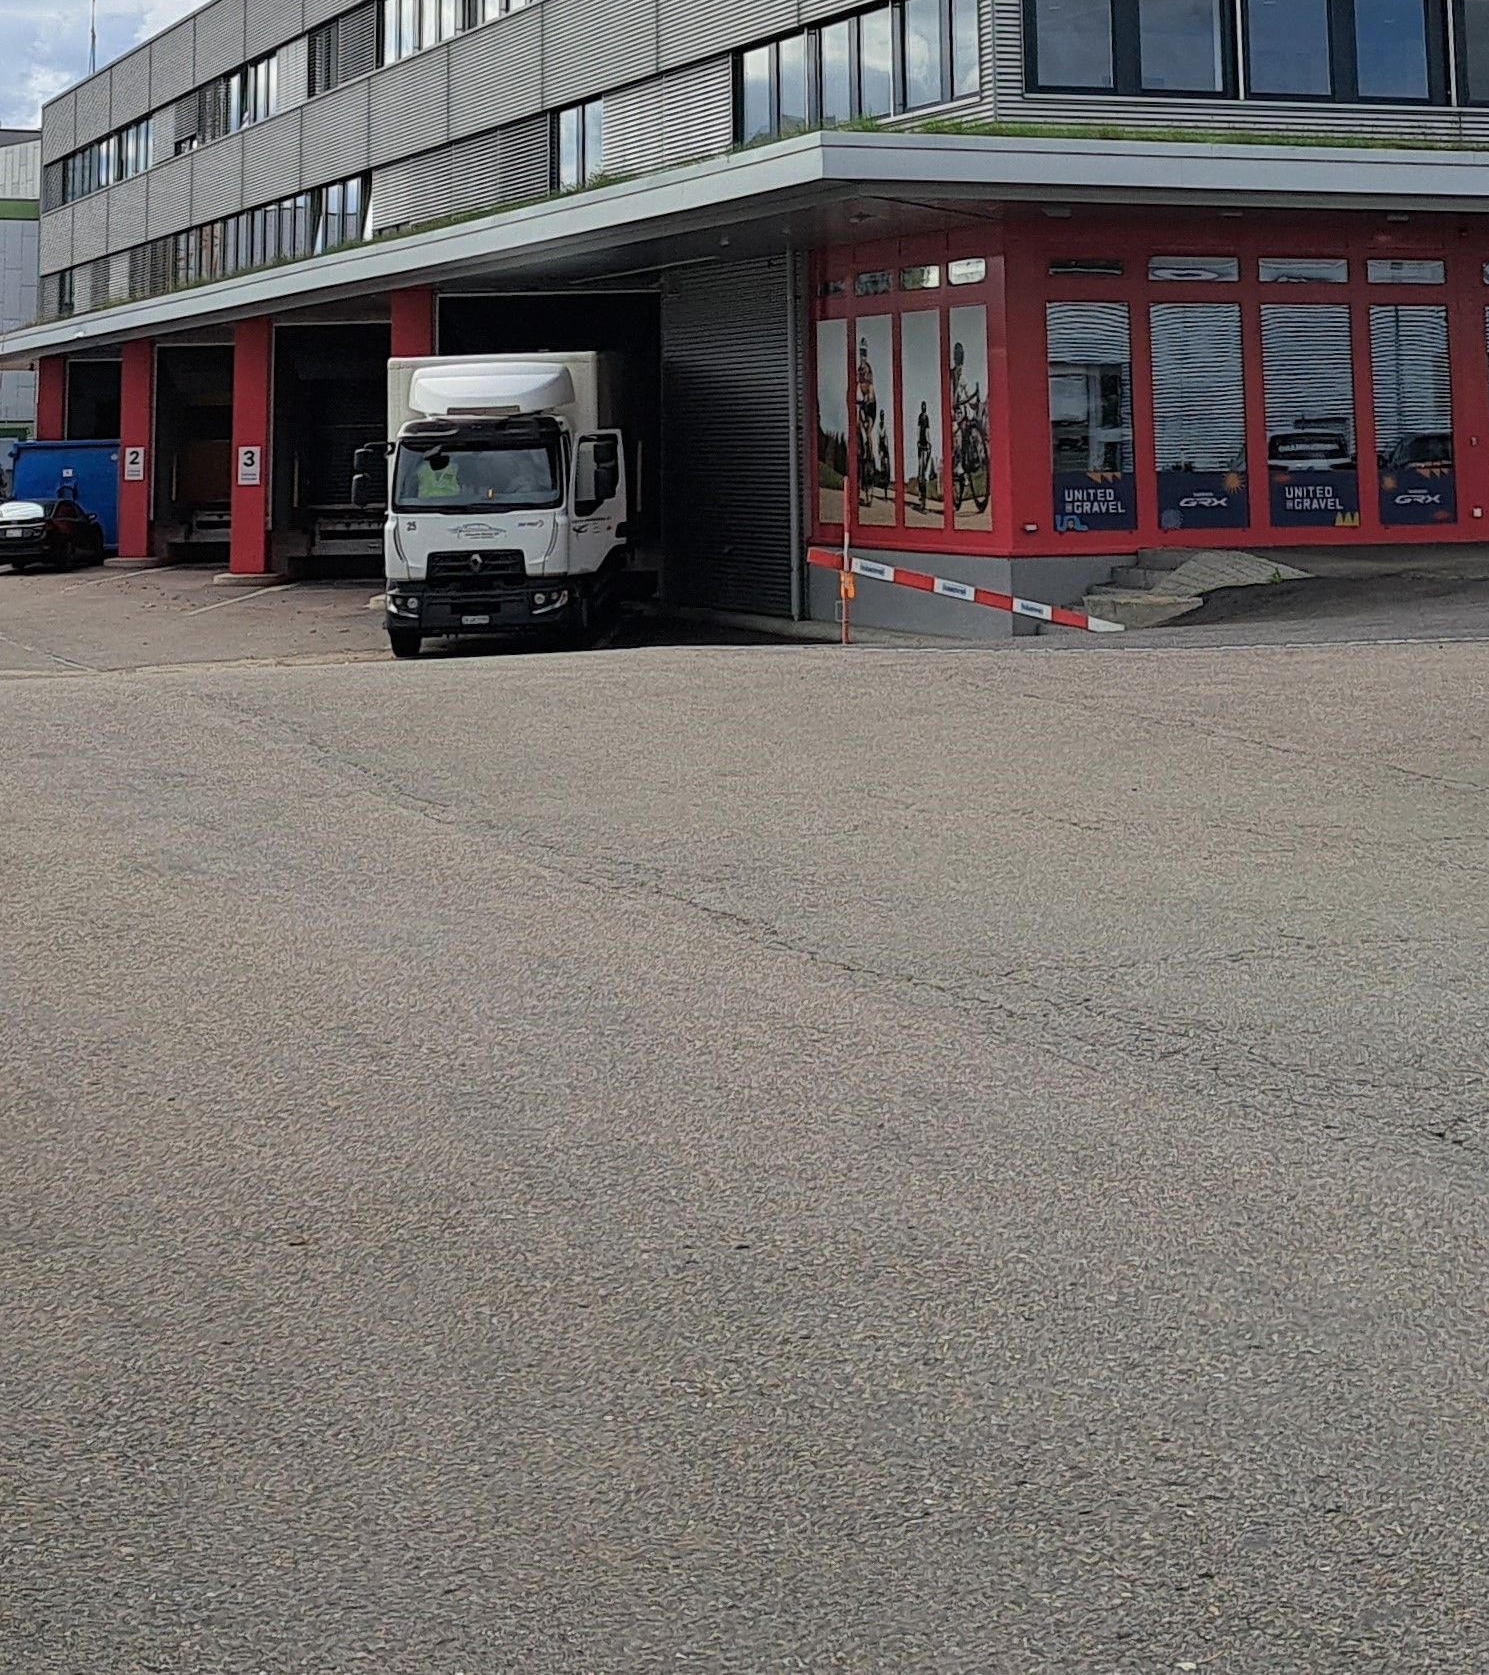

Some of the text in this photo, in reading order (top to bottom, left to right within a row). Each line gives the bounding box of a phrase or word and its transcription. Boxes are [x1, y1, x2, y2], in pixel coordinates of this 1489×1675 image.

[128, 450, 140, 465] 2
[243, 450, 255, 467] 3
[1064, 488, 1115, 501] UNITED
[1285, 486, 1333, 499] UNITED
[1178, 497, 1228, 508] GRX
[1294, 498, 1344, 511] GRAVEL
[1393, 494, 1442, 505] GRX
[1073, 501, 1126, 514] GRAVEL
